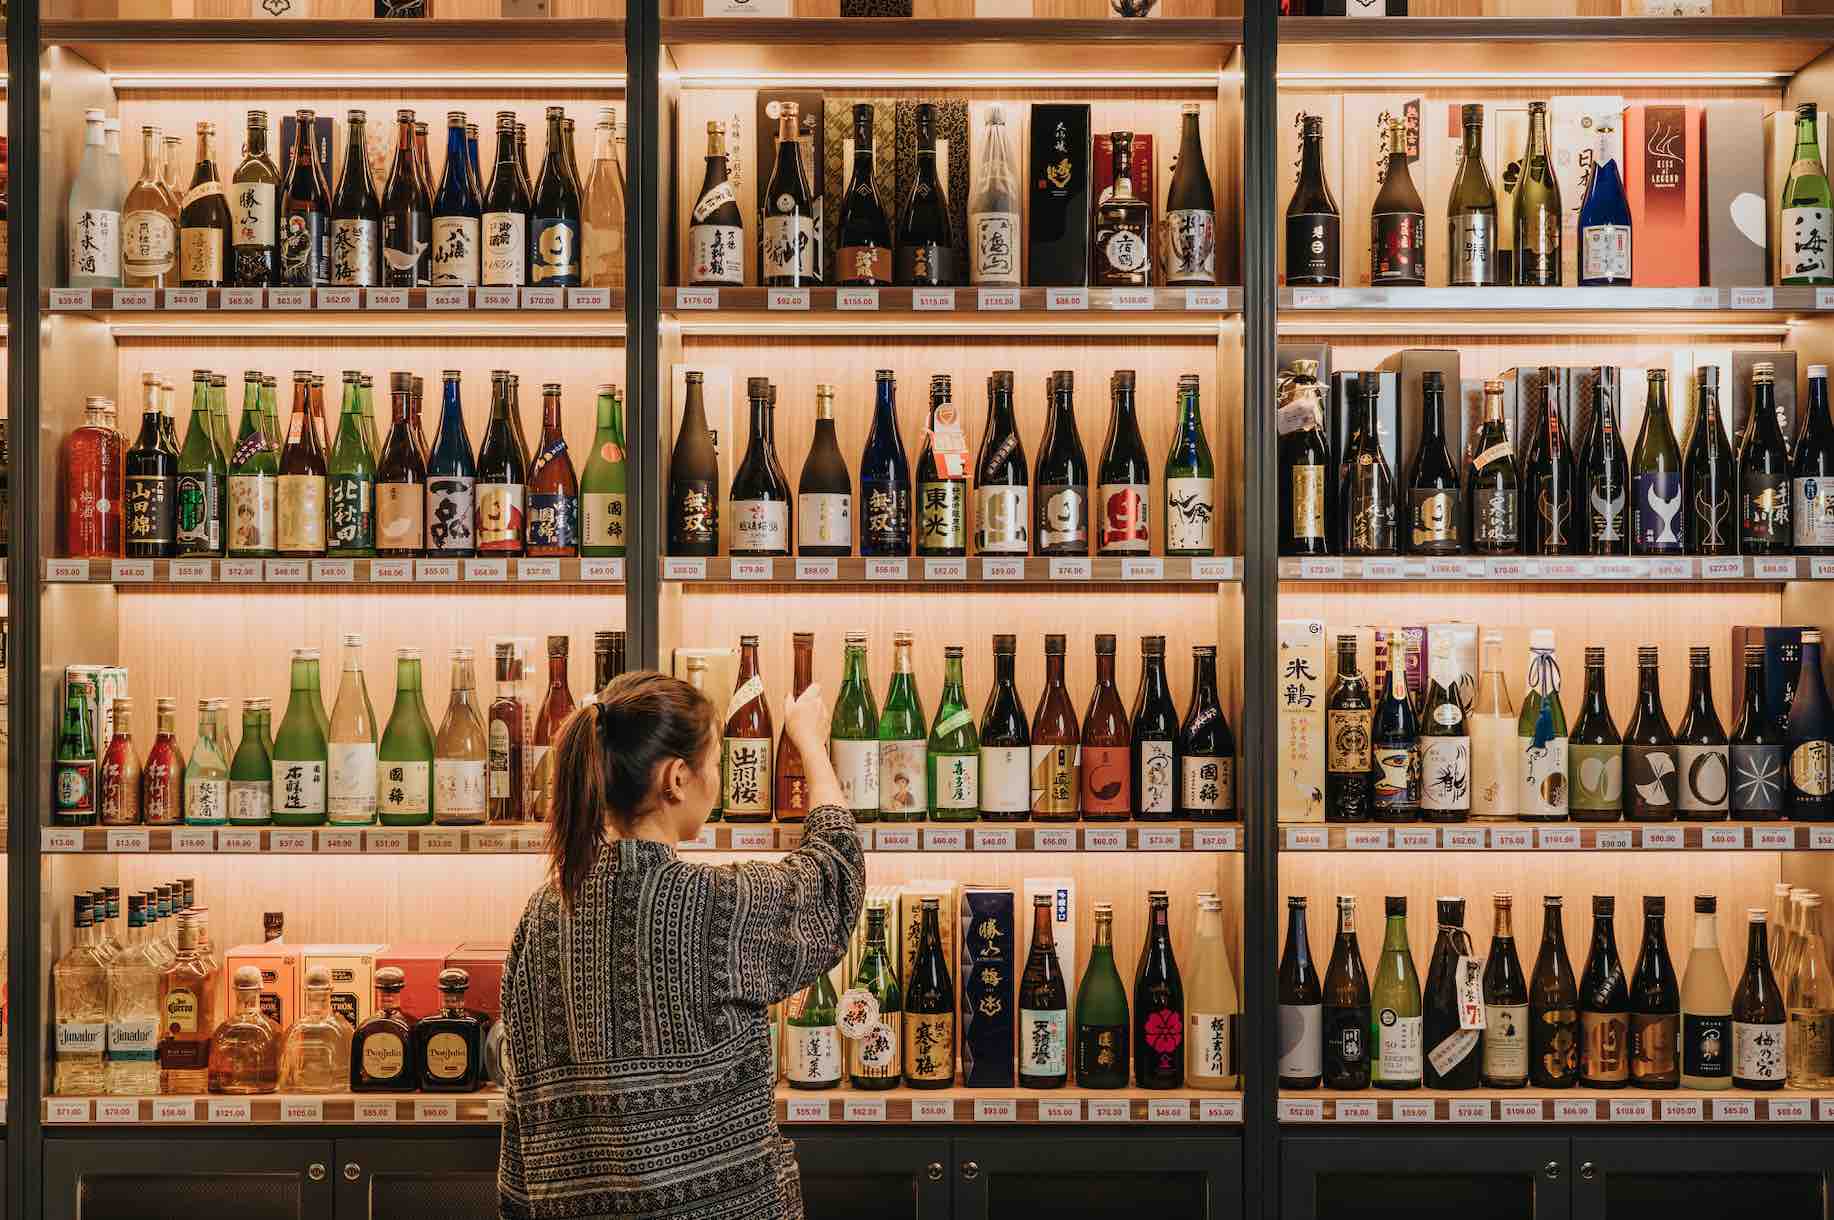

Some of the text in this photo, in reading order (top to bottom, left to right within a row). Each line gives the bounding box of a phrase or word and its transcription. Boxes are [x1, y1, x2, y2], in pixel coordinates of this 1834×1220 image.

[925, 488, 947, 536] 東光
[1285, 657, 1317, 709] 米鶴
[731, 746, 759, 805] 出羽桜
